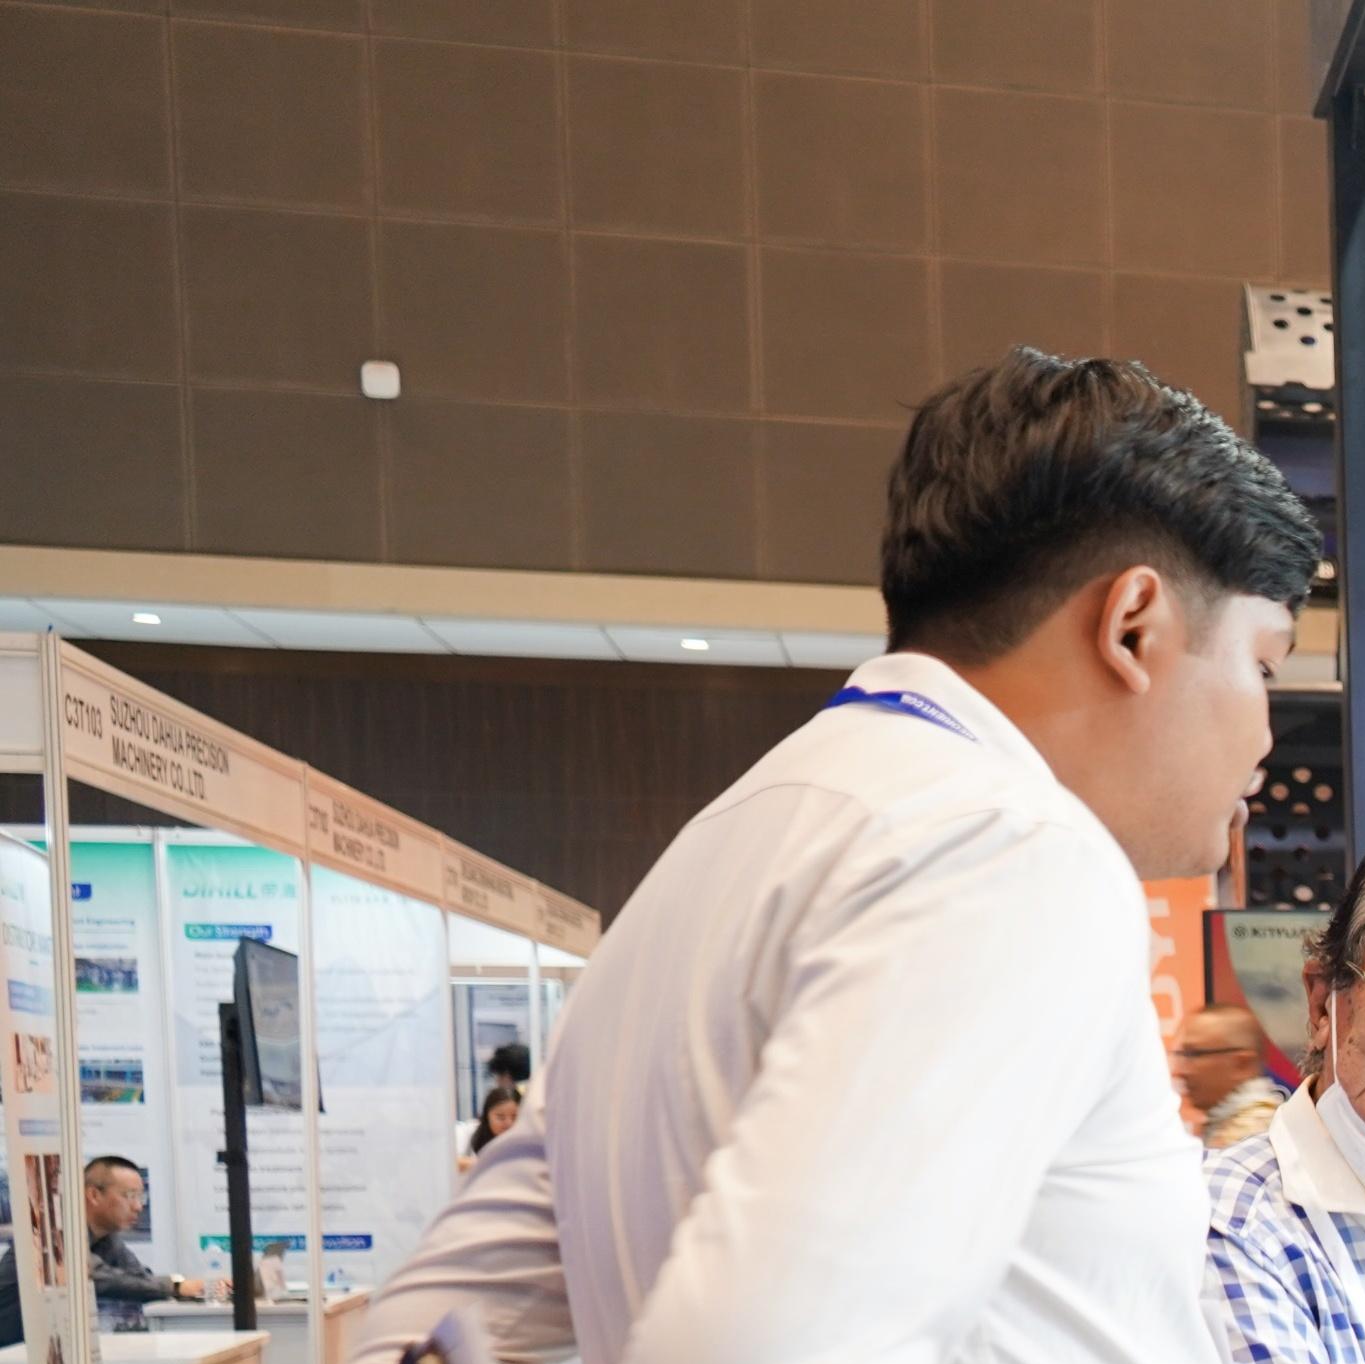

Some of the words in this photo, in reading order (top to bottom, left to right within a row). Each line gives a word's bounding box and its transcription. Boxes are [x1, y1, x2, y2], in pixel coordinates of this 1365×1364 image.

[64, 692, 103, 741] C3T103
[110, 694, 150, 741] SUZHOU
[112, 734, 168, 784] MACHINERY
